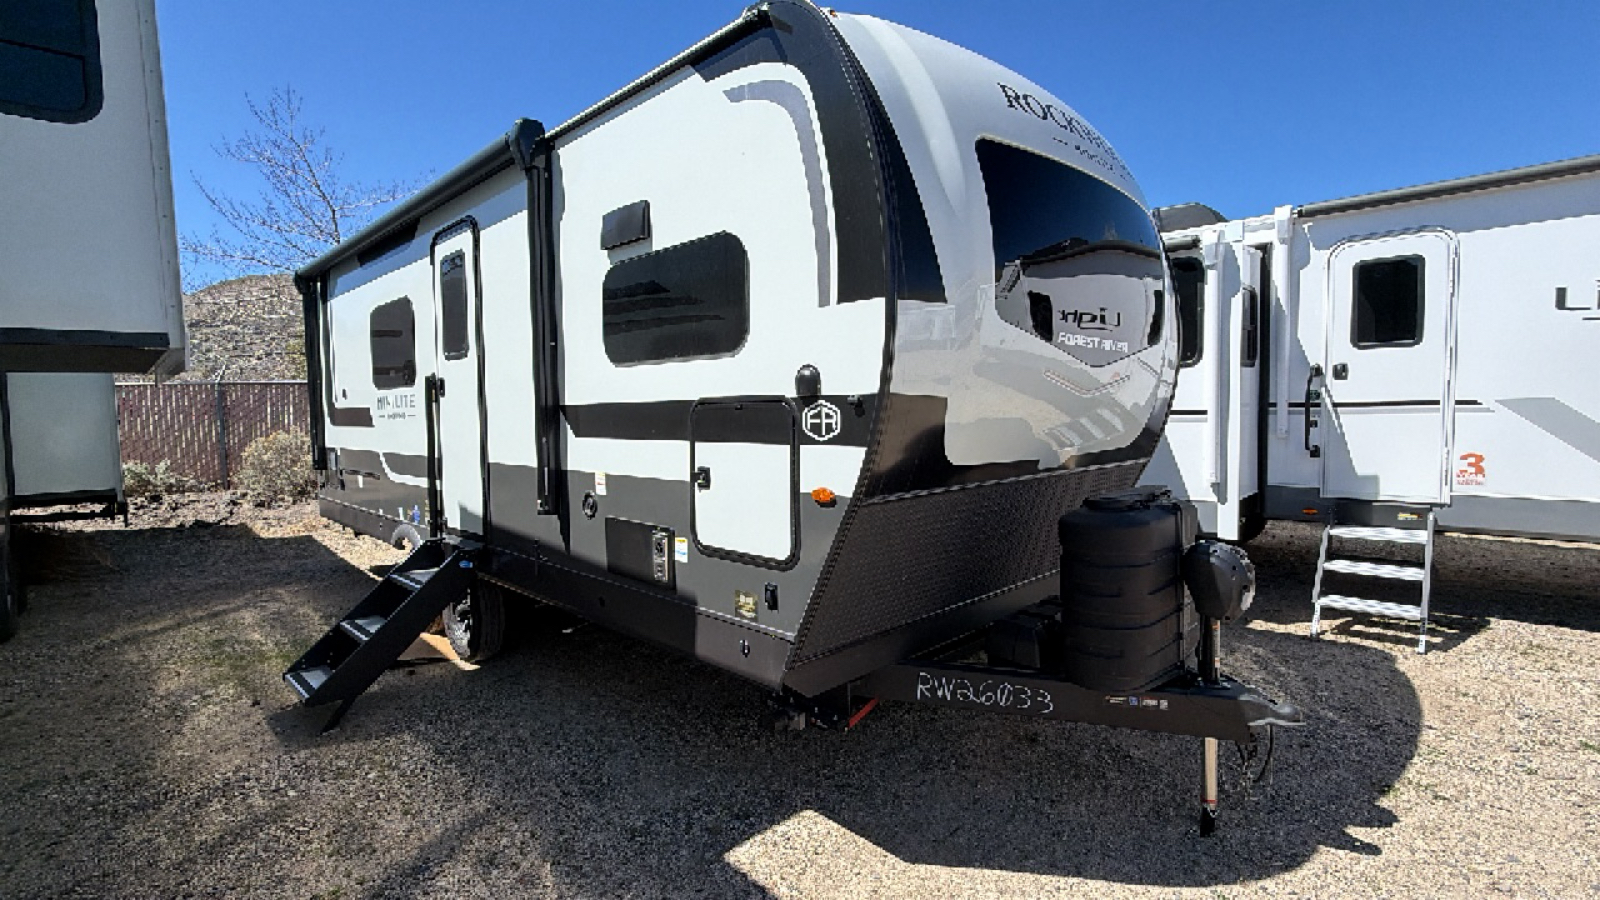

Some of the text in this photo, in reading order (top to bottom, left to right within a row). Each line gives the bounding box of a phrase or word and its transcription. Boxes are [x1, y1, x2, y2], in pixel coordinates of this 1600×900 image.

[997, 82, 1134, 180] ROCK
[1058, 332, 1128, 353] FOREST RIVER
